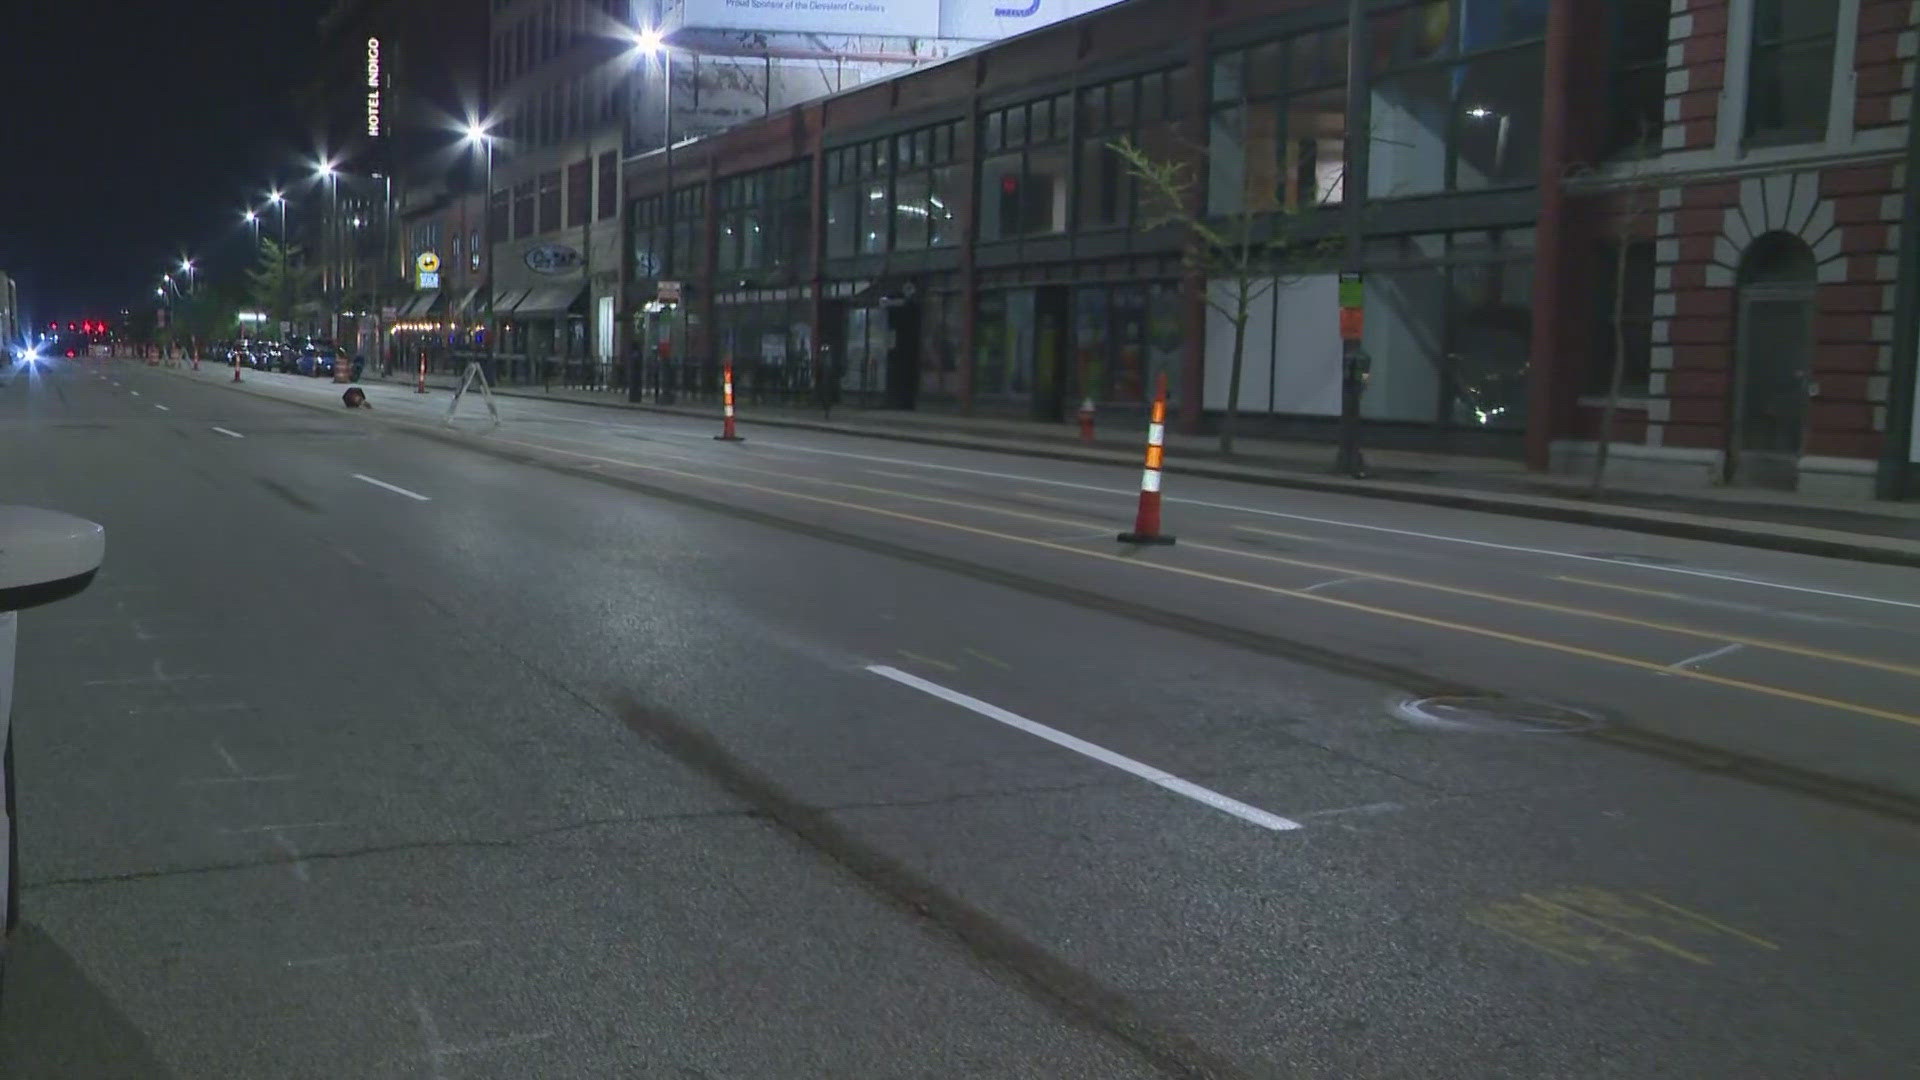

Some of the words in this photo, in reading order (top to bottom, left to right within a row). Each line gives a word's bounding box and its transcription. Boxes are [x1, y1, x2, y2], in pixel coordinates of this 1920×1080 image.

[725, 0, 749, 8] Proud
[752, 0, 783, 9] Sponsor
[785, 0, 793, 9] of
[795, 1, 808, 10] the
[809, 1, 847, 11] Cleveland
[849, 2, 886, 13] Cavaliers
[368, 37, 380, 87] INDIGO
[368, 89, 380, 137] HOTEL
